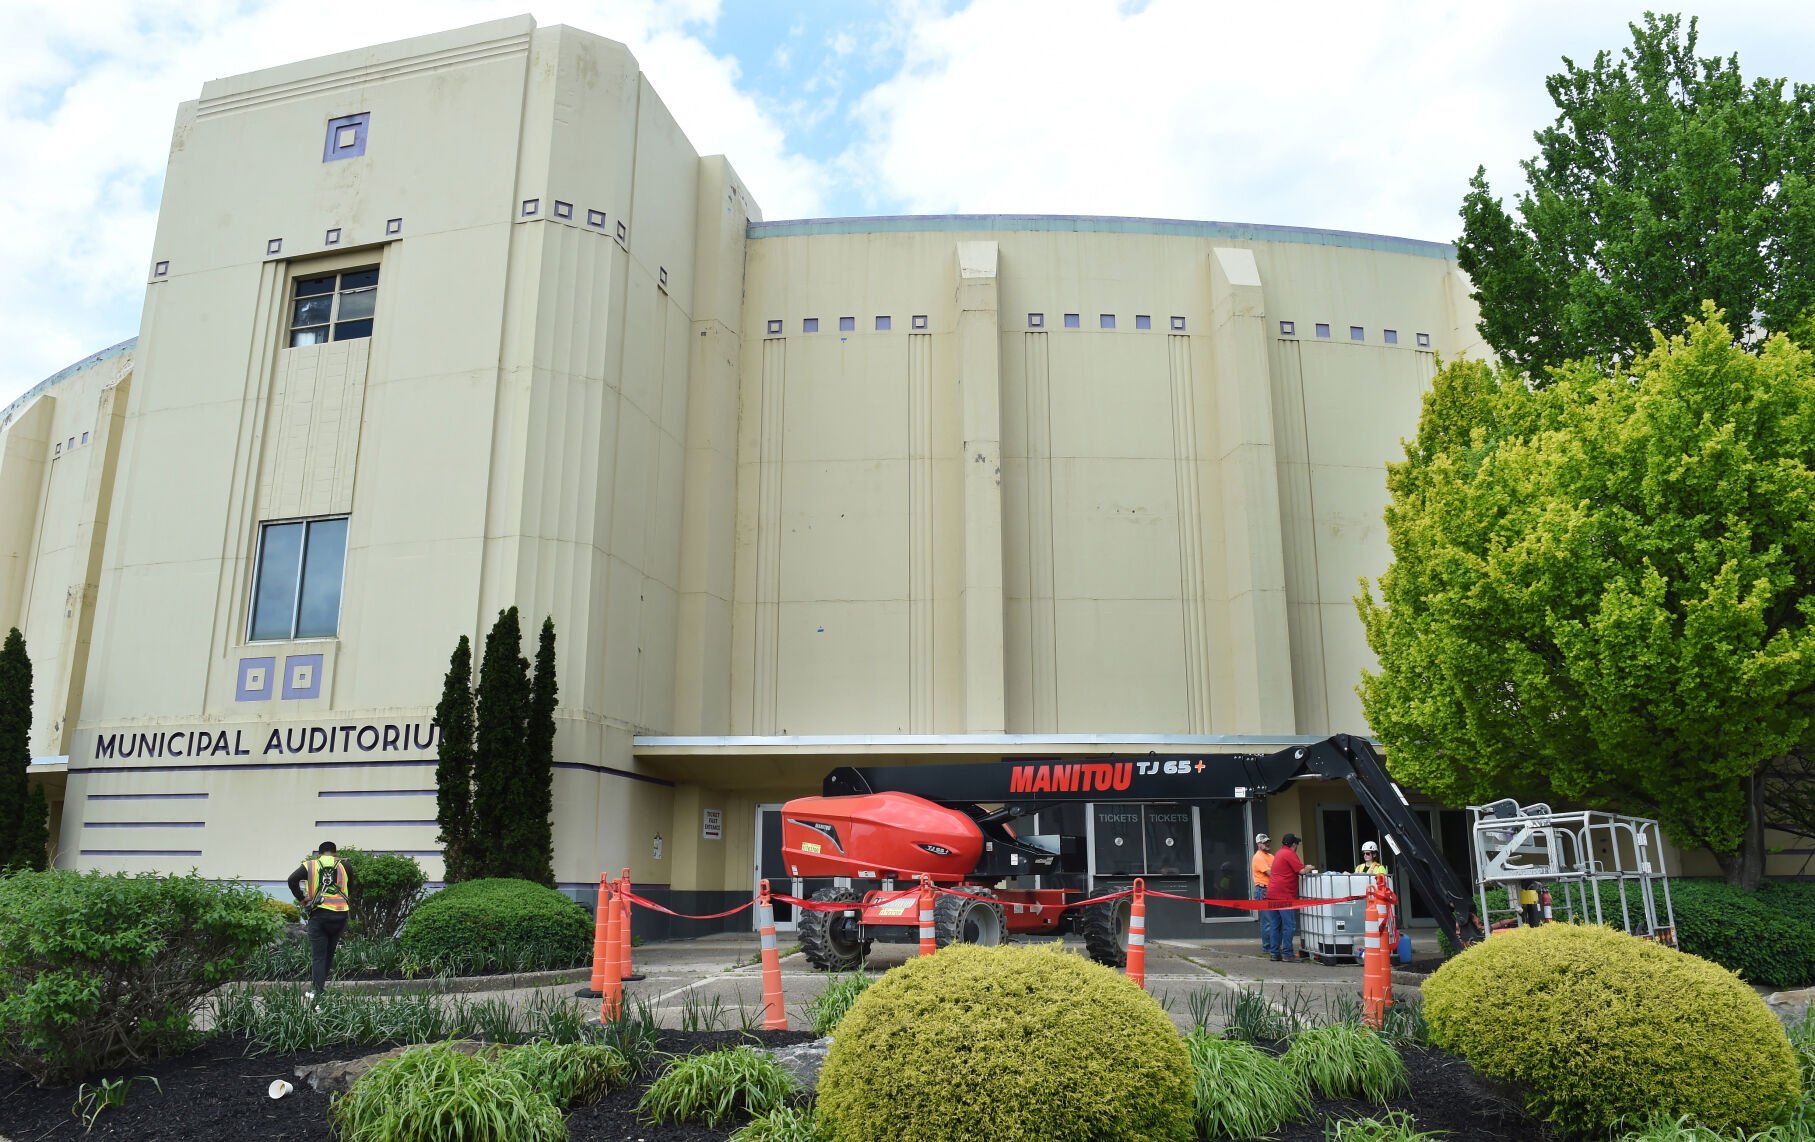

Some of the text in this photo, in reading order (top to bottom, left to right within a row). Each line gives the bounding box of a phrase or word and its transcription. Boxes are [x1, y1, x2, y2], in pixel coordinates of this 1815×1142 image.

[95, 729, 250, 759] MUNICIPAL
[1009, 762, 1133, 793] MANITOU
[1136, 760, 1160, 775] TJ
[1099, 814, 1138, 823] TICKETS
[1150, 814, 1188, 823] TICKETS
